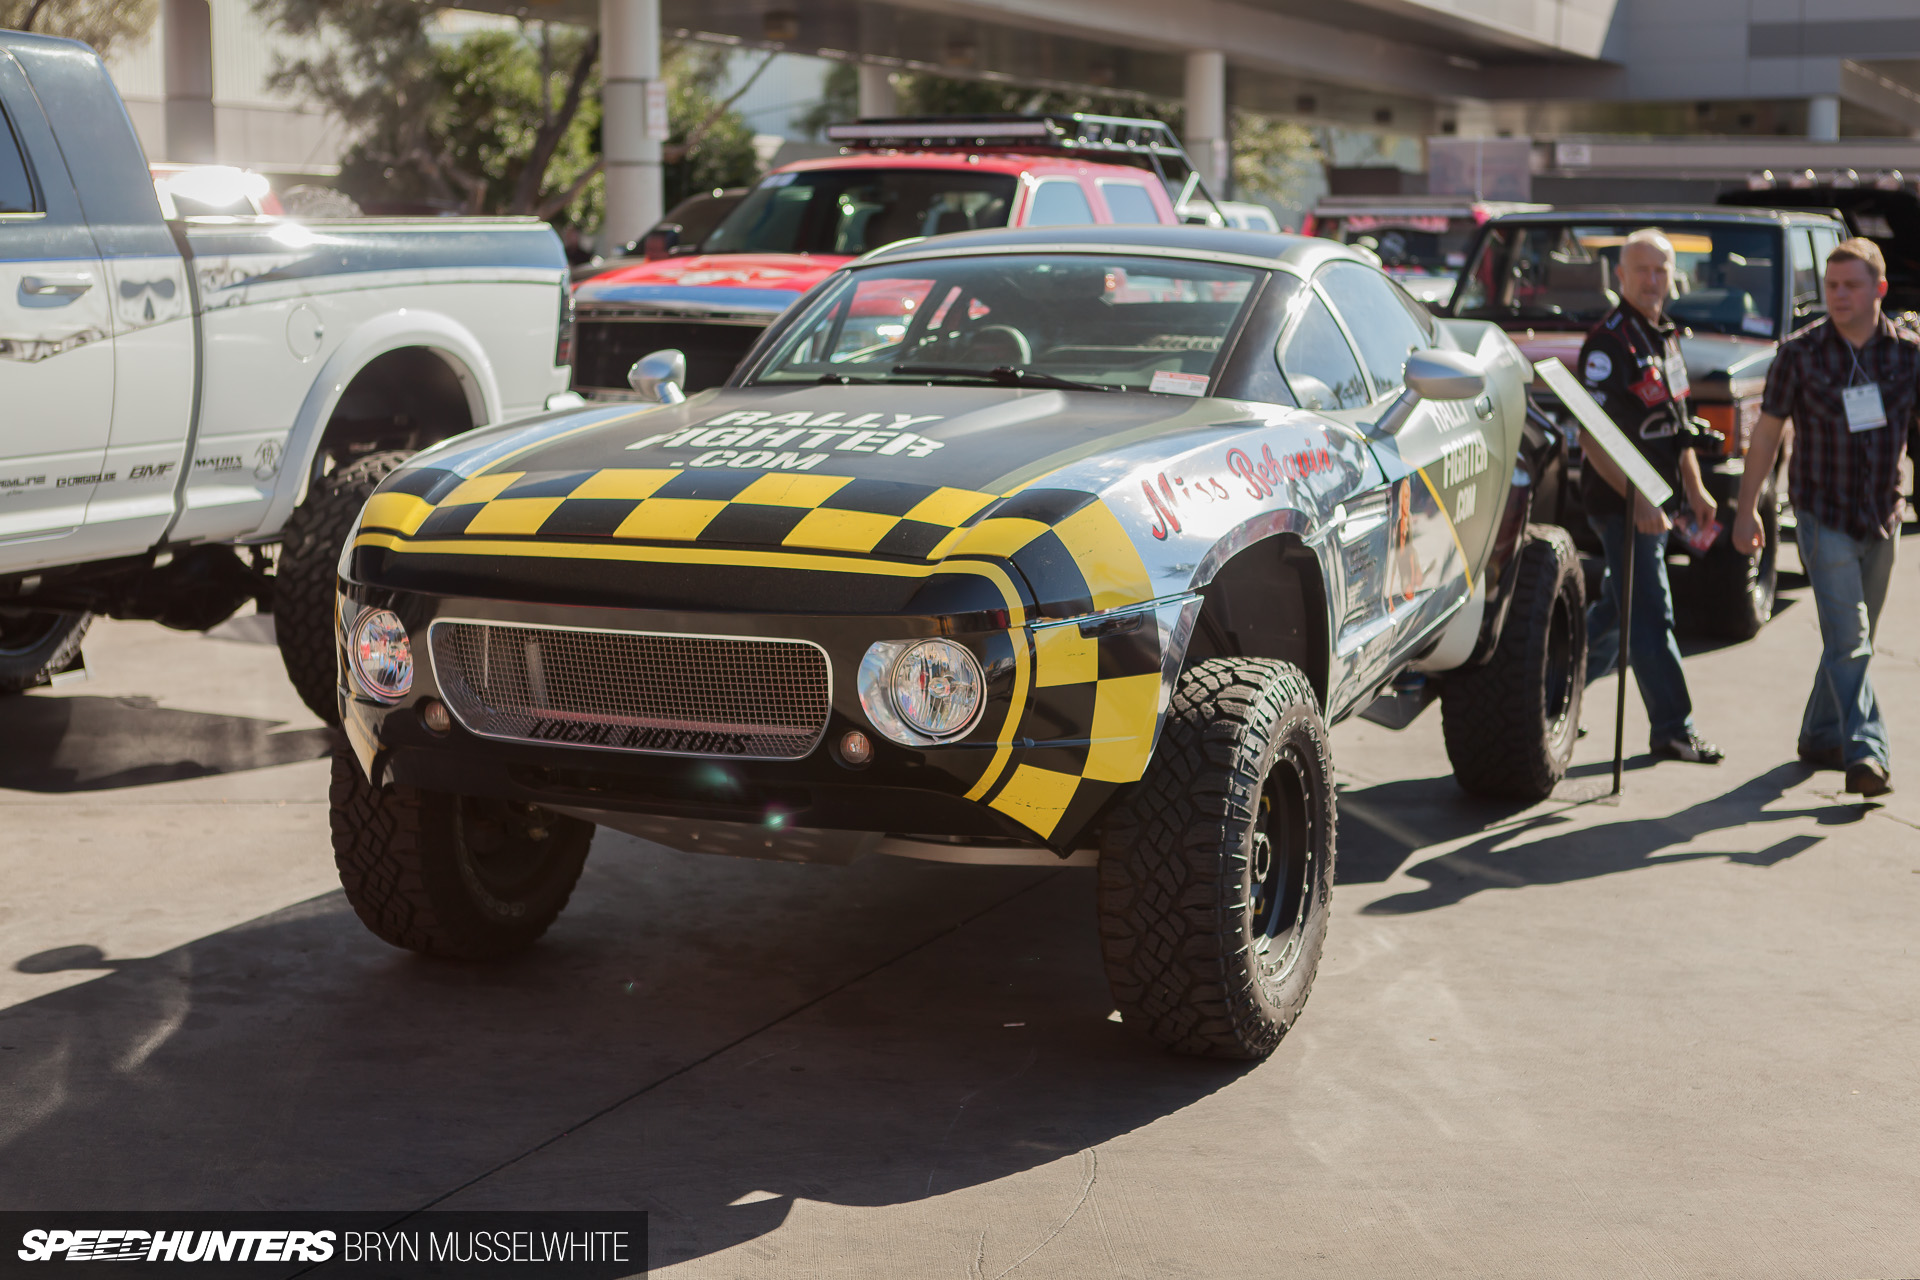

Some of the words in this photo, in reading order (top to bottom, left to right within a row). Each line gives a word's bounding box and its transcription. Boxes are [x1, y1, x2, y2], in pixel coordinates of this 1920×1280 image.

[705, 410, 945, 429] RALLY
[624, 426, 945, 458] FIGHTER
[129, 461, 176, 480] BMF
[669, 449, 830, 471] .COM
[1440, 430, 1488, 490] FIGHTER
[528, 717, 612, 746] LOCAL
[622, 728, 750, 755] MOTORS
